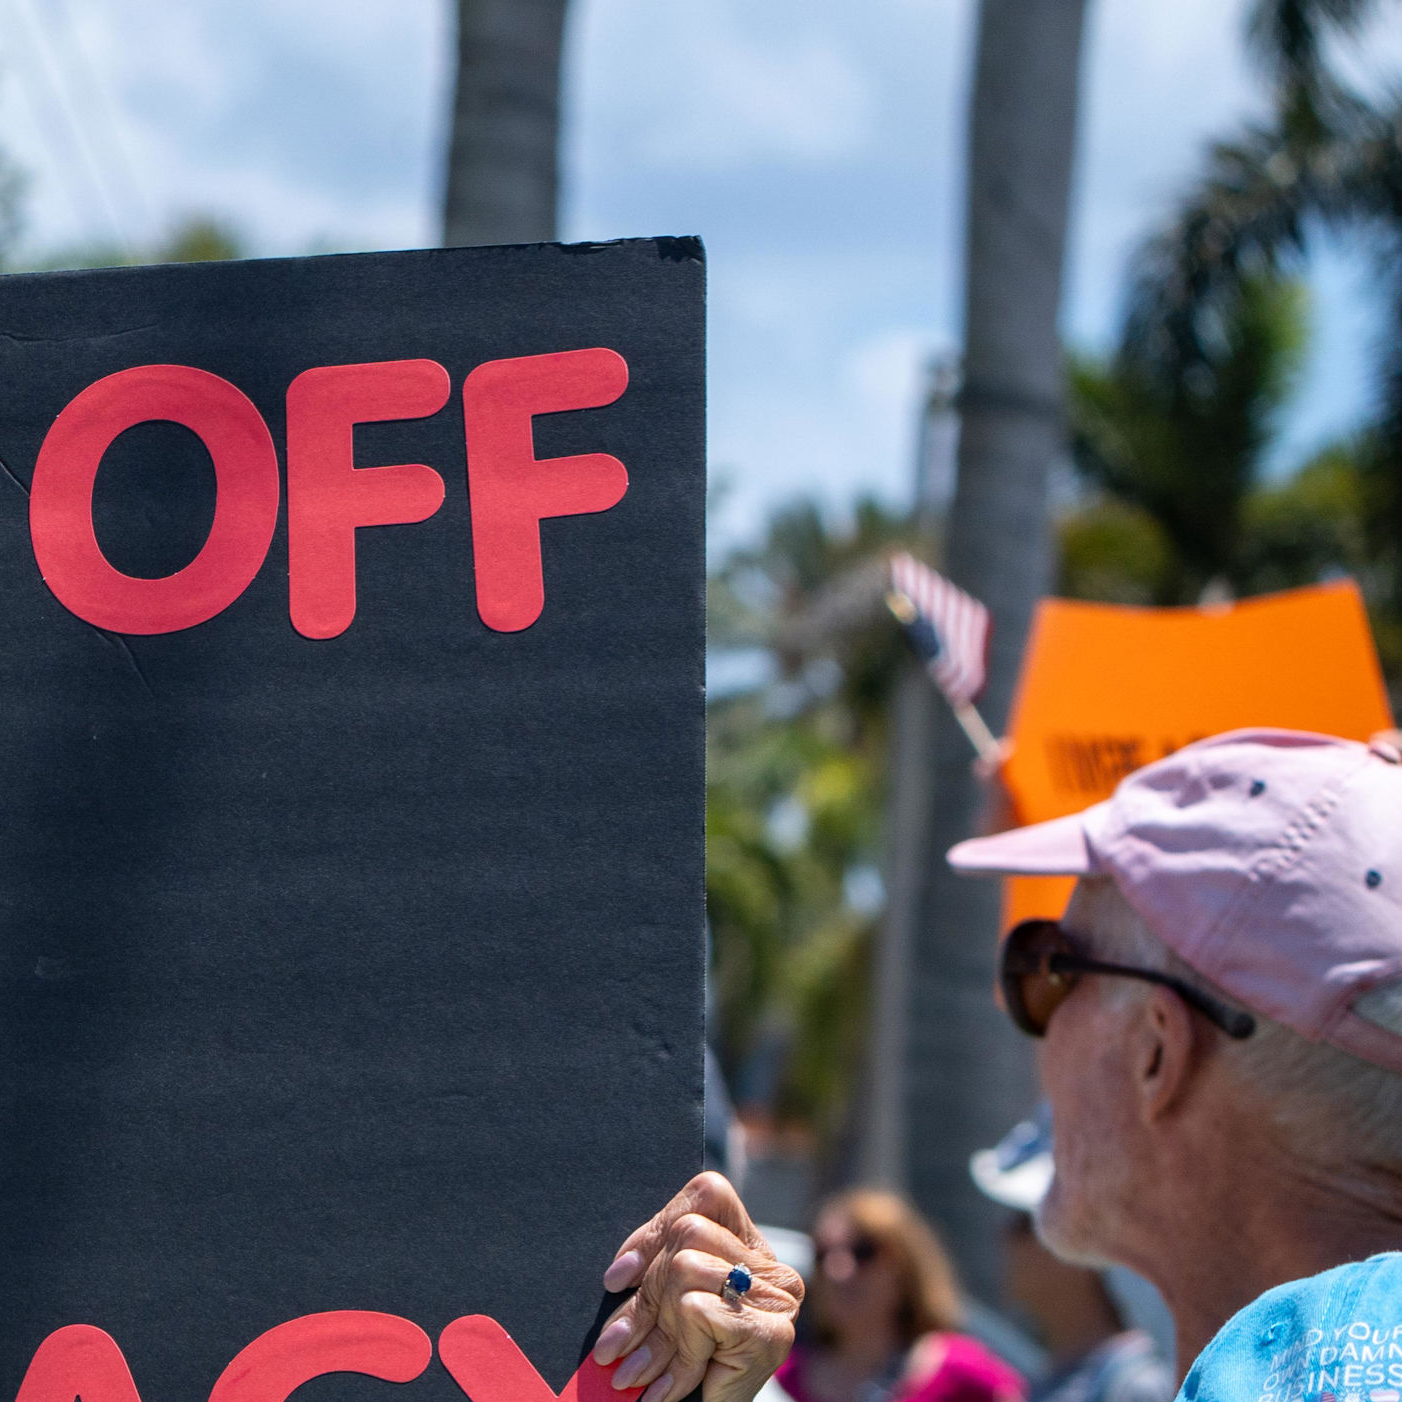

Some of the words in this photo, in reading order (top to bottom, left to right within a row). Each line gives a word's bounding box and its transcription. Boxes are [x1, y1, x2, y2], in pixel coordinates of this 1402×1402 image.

[29, 346, 630, 640] OFF
[1263, 1349, 1311, 1392] OWN
[1319, 1341, 1402, 1366] DAMN
[1269, 1328, 1323, 1372] MIND
